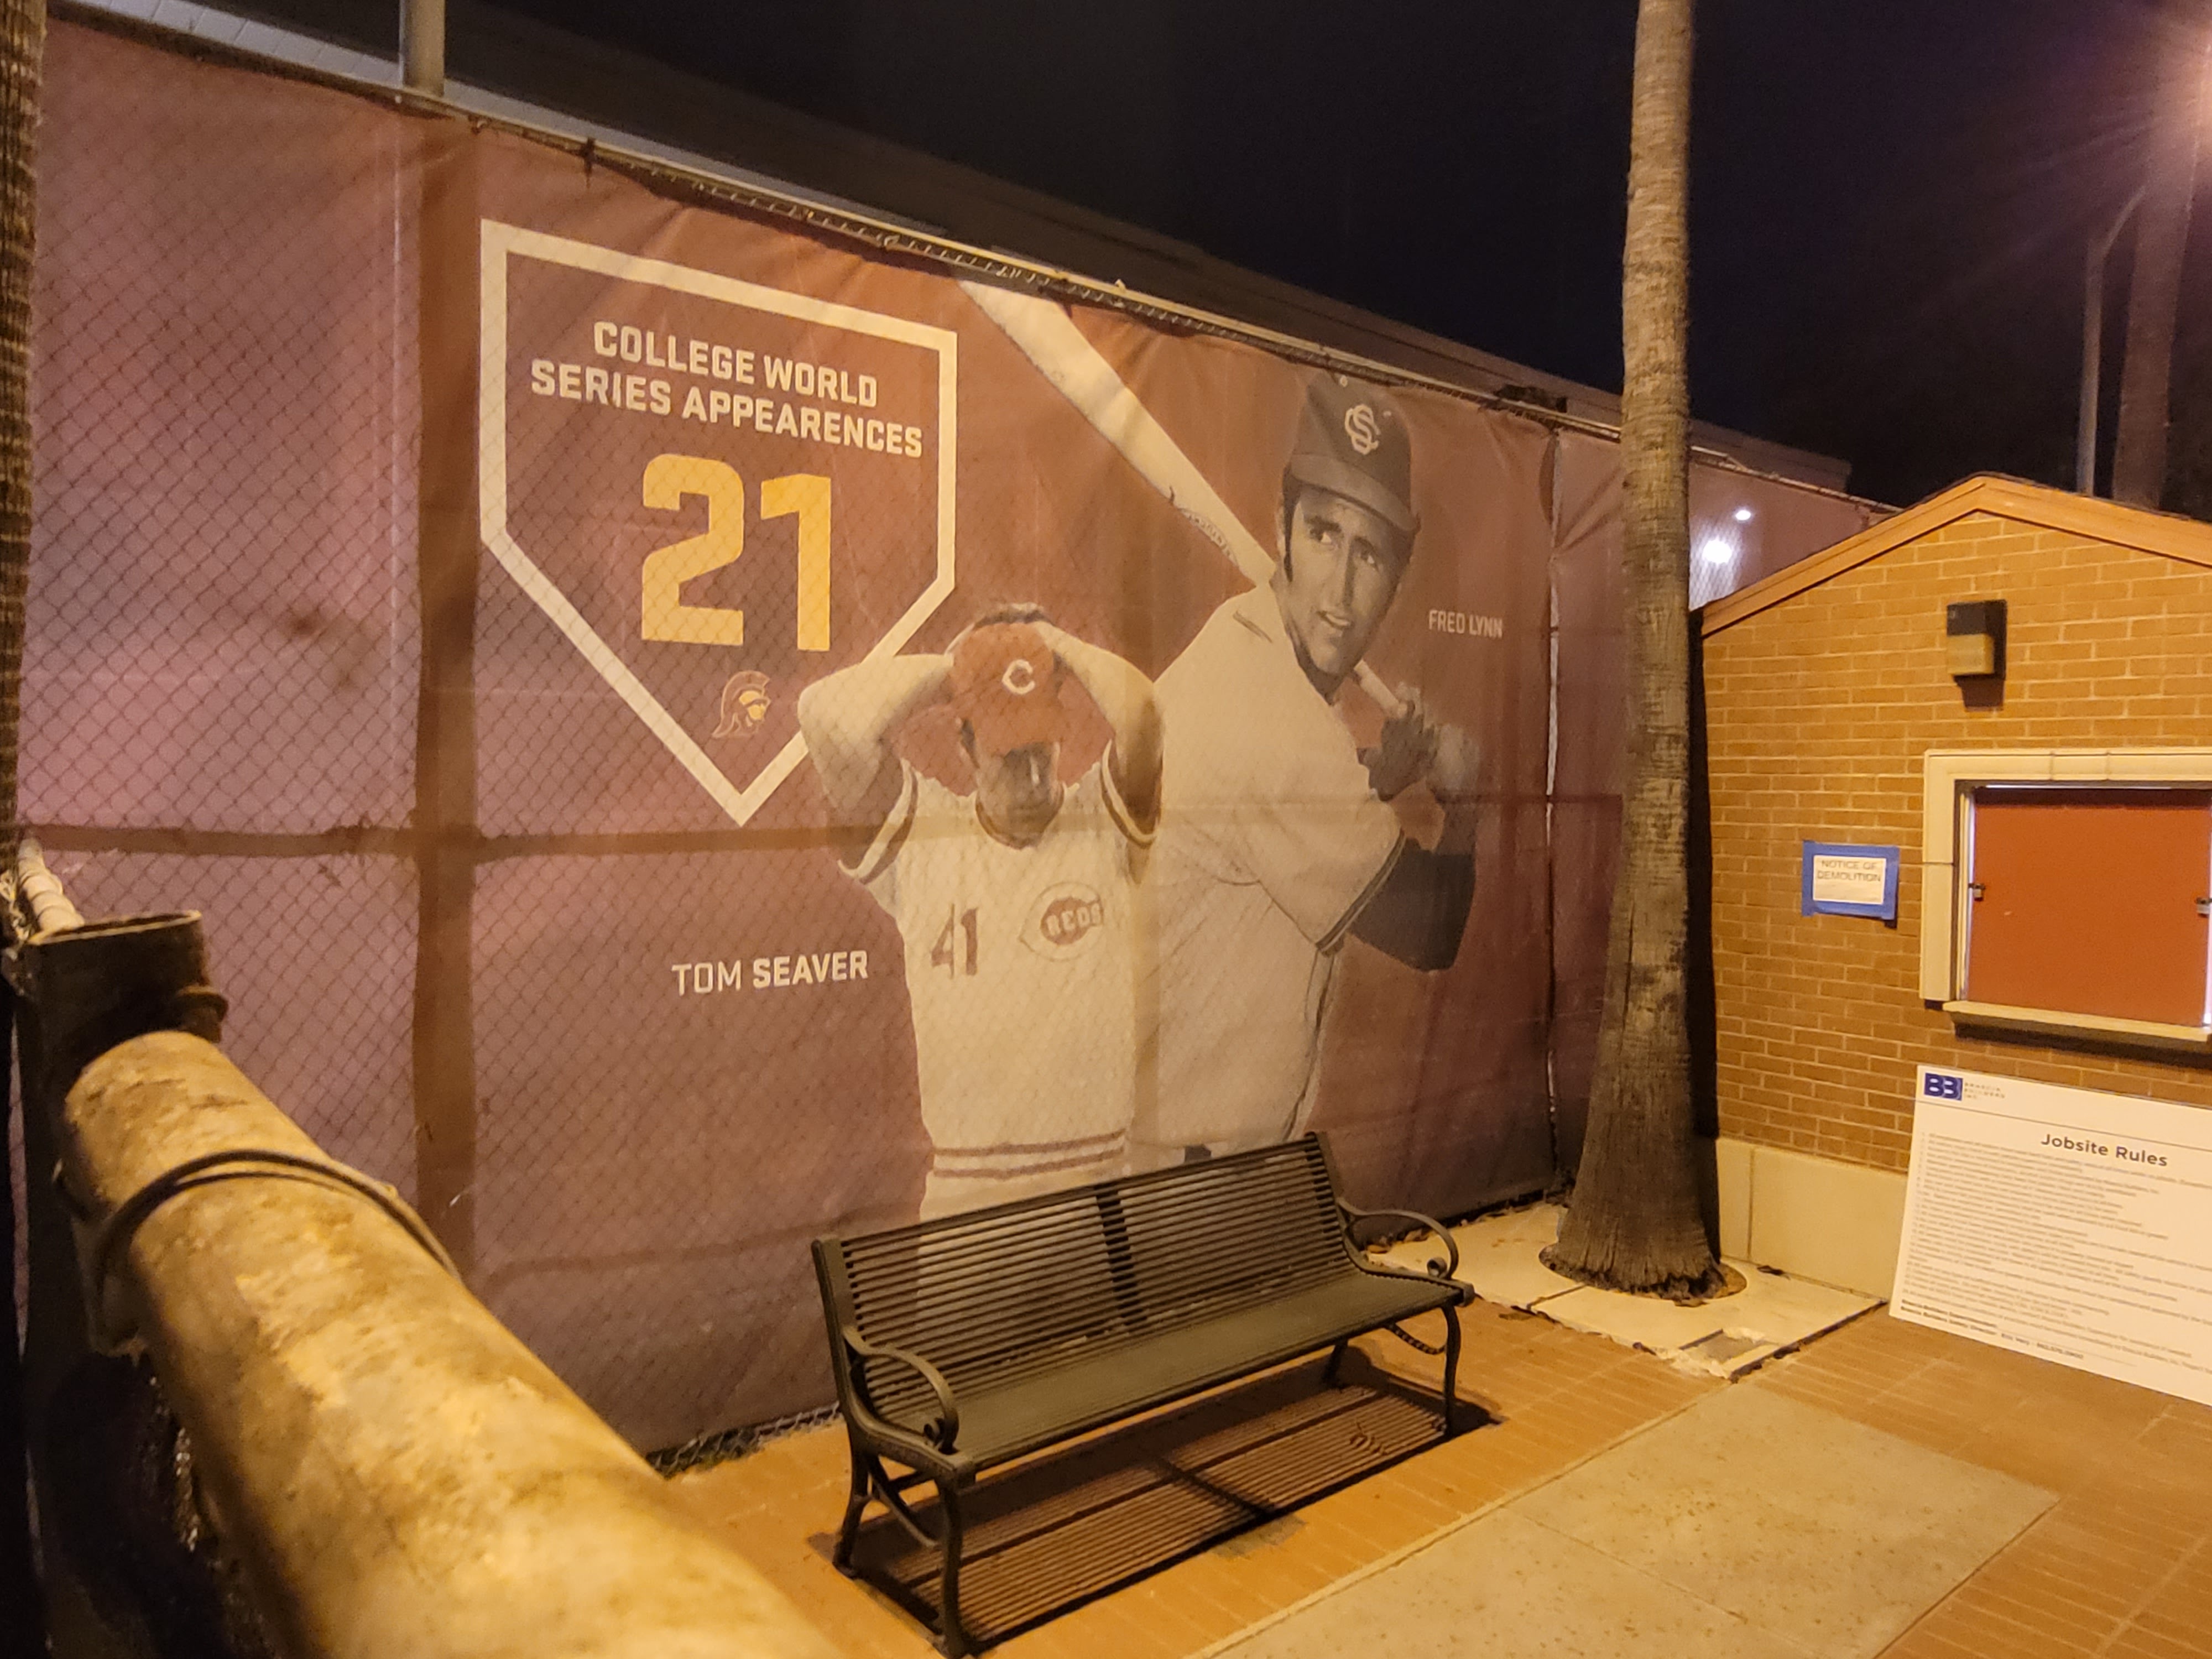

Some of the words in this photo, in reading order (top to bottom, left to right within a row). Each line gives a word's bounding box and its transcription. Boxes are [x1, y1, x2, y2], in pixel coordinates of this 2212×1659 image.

[593, 321, 755, 384] COLLEGE
[764, 355, 878, 408] WORLD
[531, 359, 671, 415] SERIES
[682, 387, 922, 458] APPEARENCES
[641, 453, 832, 651] 21
[1428, 609, 1466, 634] FRED
[1468, 615, 1503, 639] LYNN
[1001, 658, 1036, 695] C
[1817, 871, 1881, 881] DEMOLITION
[1822, 860, 1859, 869] NOTICE
[930, 903, 979, 979] 41
[671, 960, 742, 996] TOM
[752, 950, 869, 989] SEAVER
[2041, 1134, 2109, 1156] Jobsite
[2115, 1146, 2168, 1167] Rules
